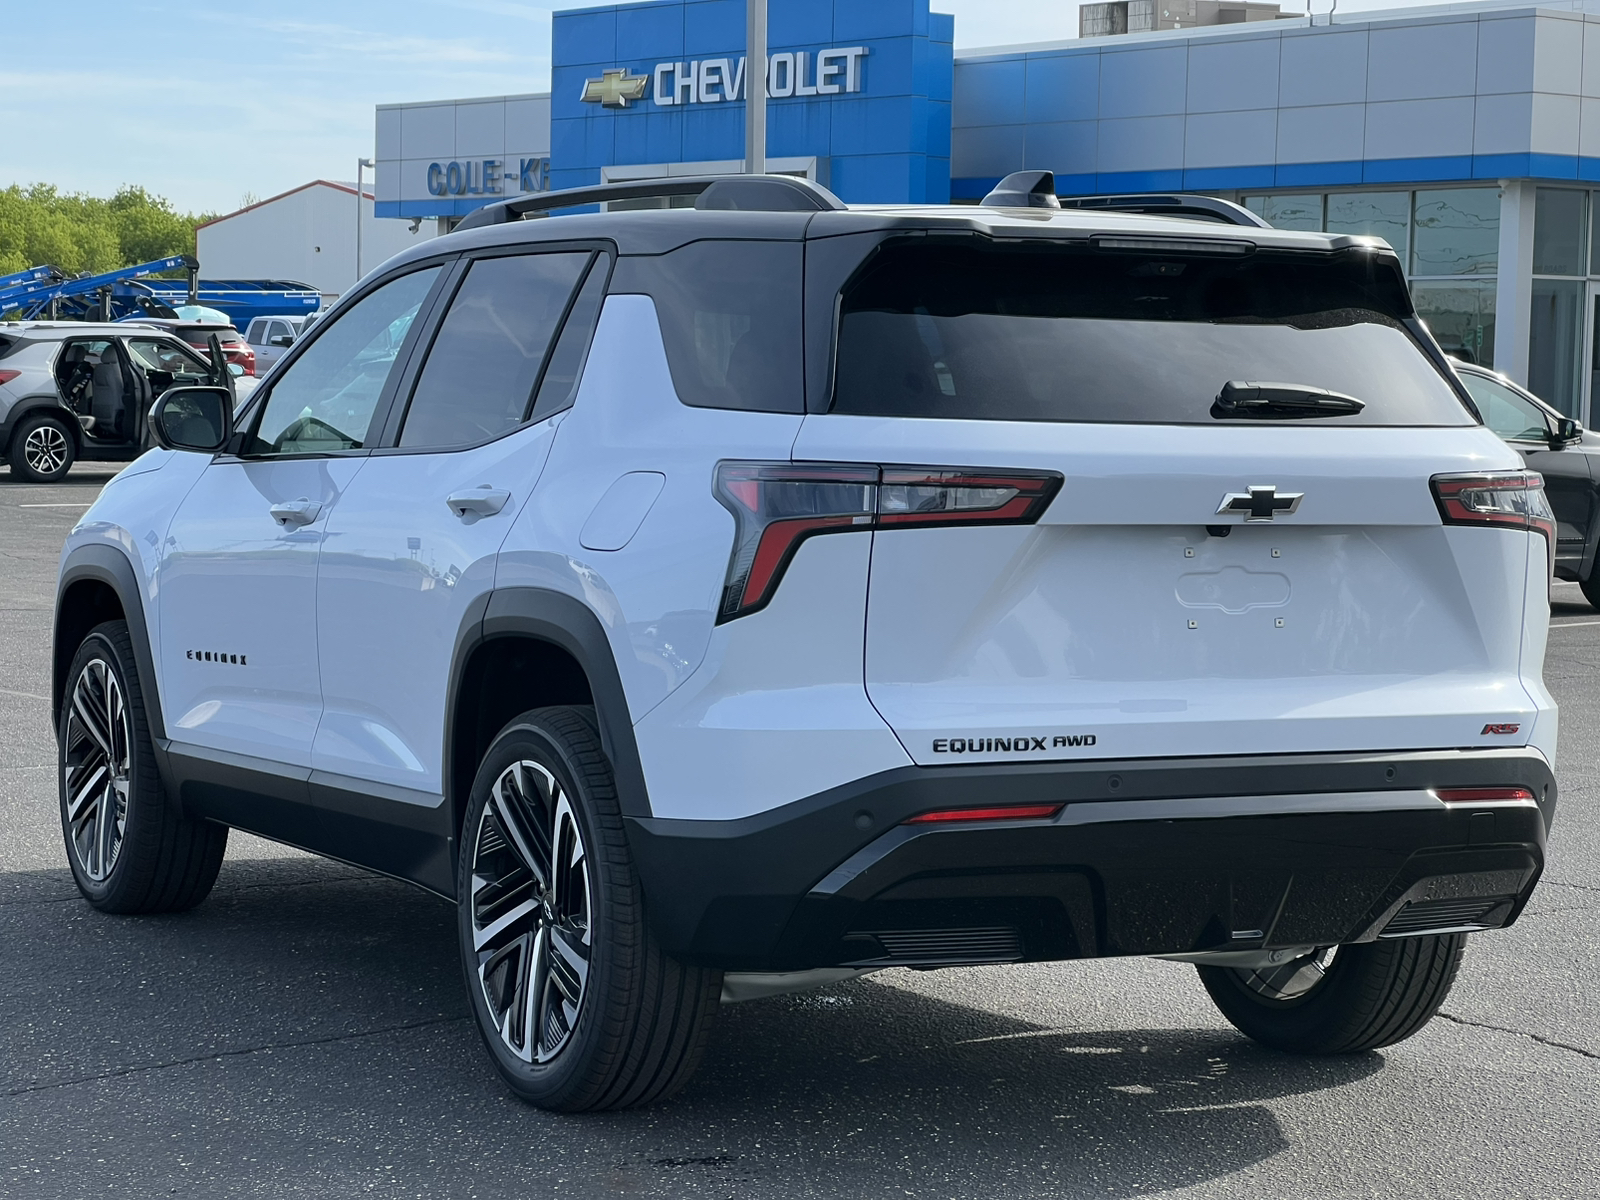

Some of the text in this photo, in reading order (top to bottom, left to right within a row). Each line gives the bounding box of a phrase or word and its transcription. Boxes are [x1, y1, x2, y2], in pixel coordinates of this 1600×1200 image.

[654, 47, 868, 106] CHEVOLET
[186, 649, 247, 666] EQUINOX
[1480, 723, 1521, 735] RS
[932, 734, 1097, 754] EQUINOX AWD
